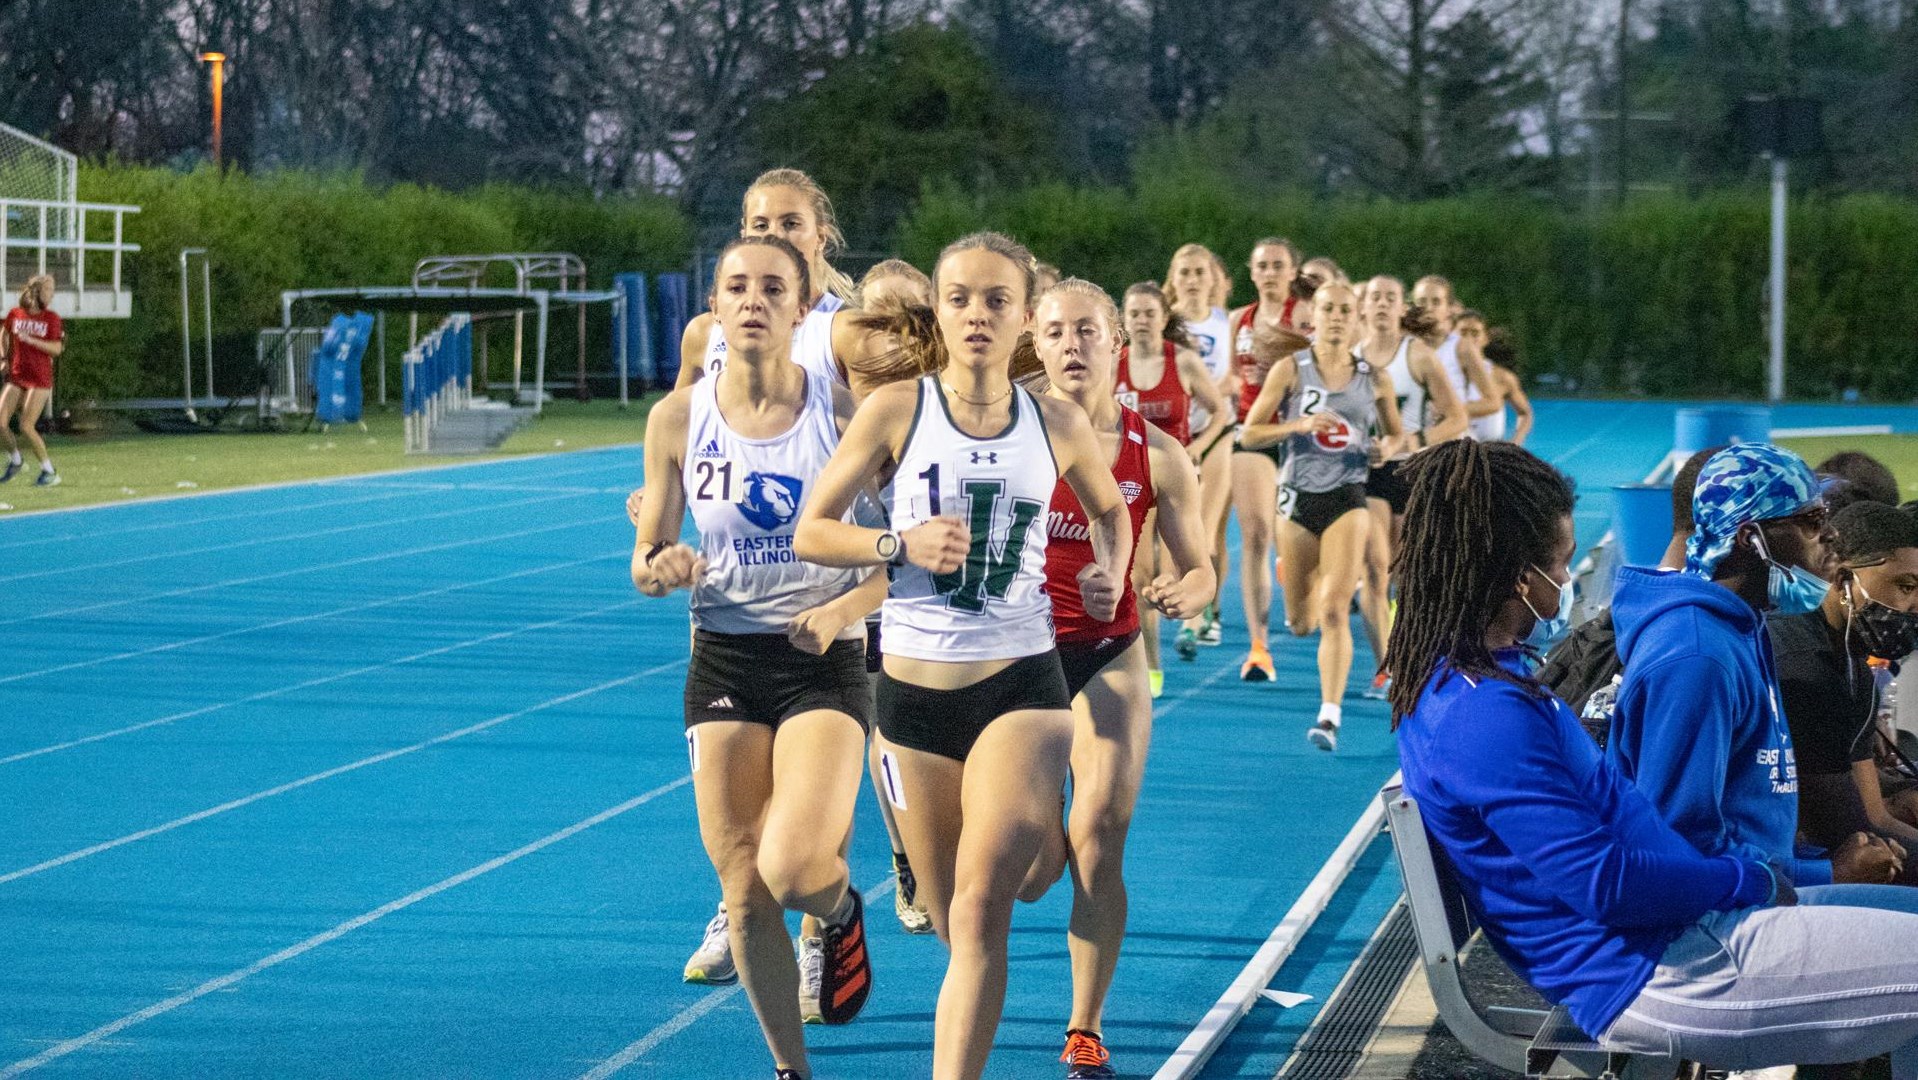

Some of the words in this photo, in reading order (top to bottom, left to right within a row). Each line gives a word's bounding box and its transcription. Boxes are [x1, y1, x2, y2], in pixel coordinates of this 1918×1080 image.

[1303, 389, 1321, 415] 2
[696, 461, 732, 500] 21
[918, 463, 941, 516] 1
[882, 754, 897, 803] 1
